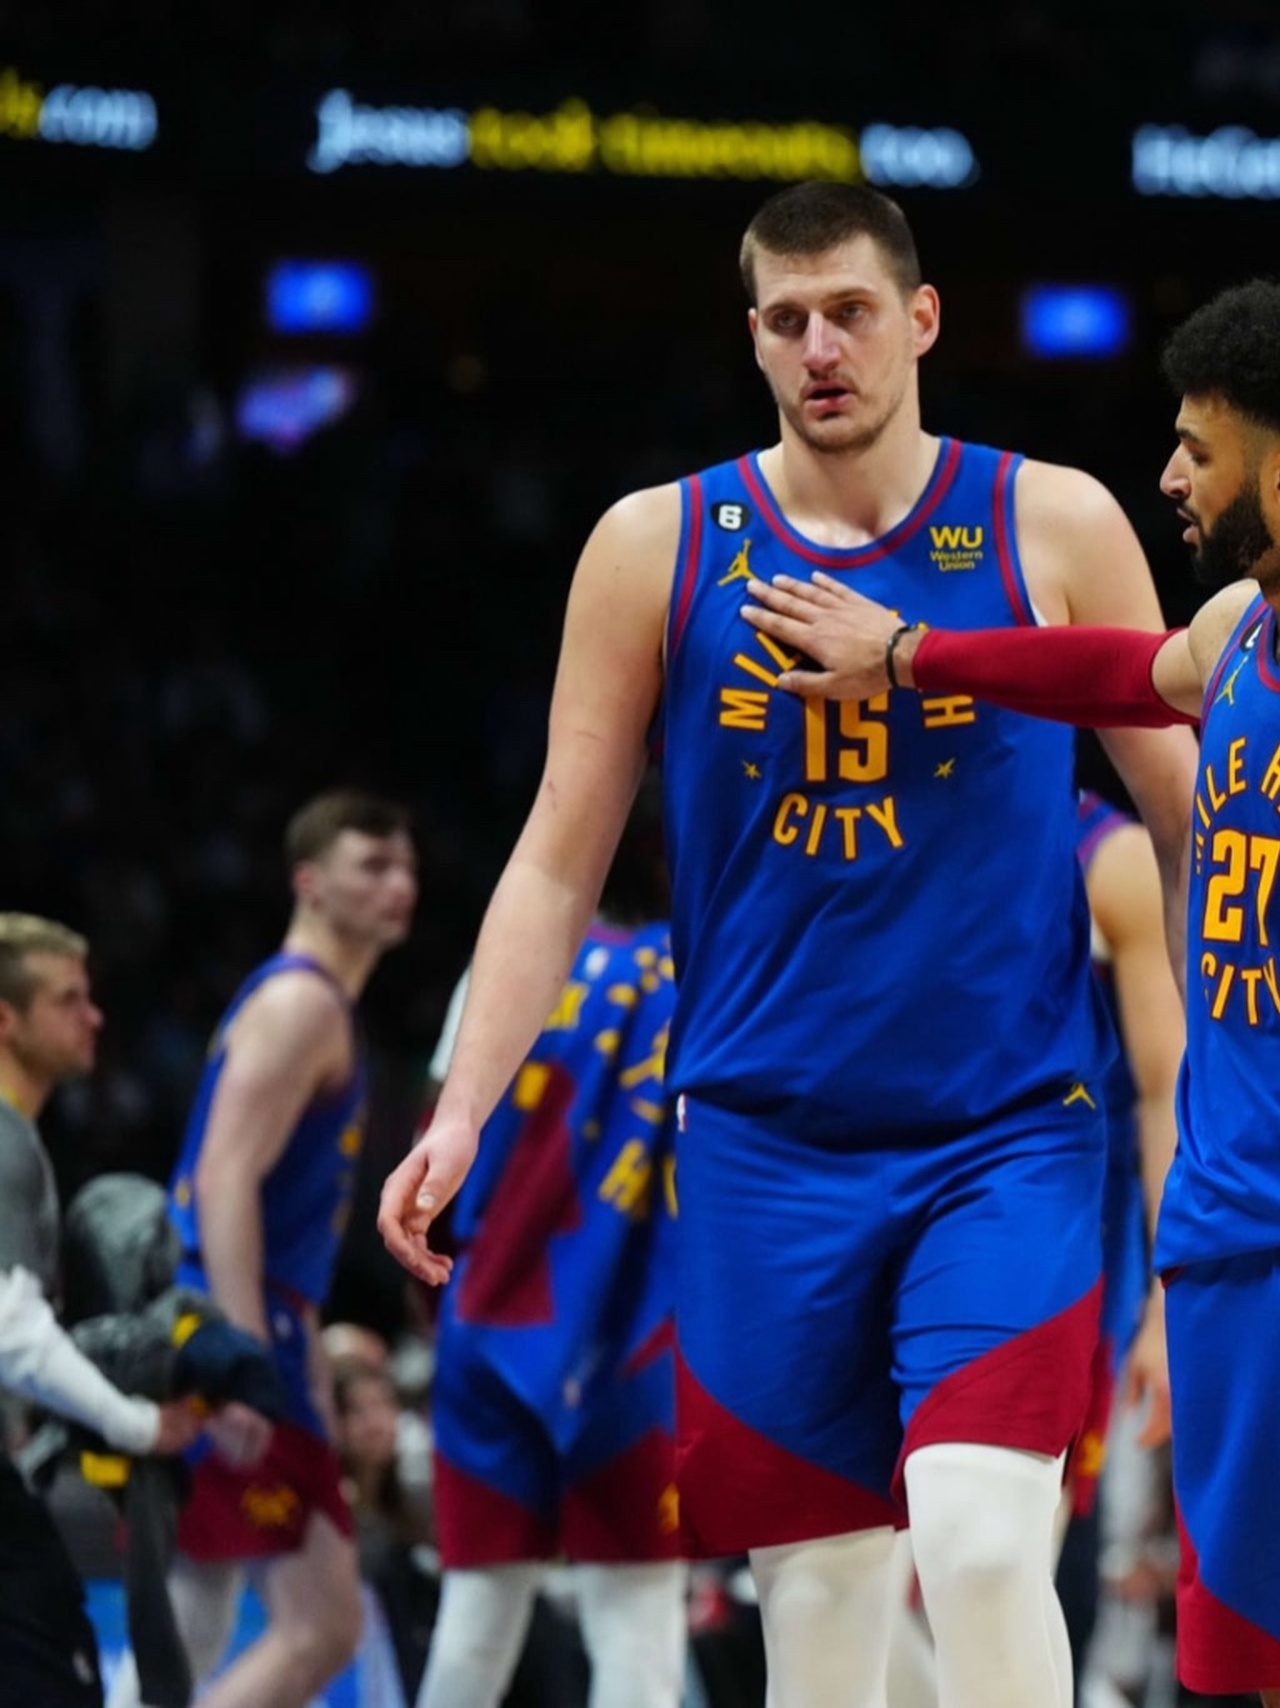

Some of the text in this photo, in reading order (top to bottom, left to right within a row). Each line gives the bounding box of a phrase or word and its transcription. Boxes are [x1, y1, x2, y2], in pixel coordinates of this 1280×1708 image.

[718, 505, 743, 530] 6
[930, 525, 983, 548] WU
[930, 549, 984, 562] Western
[938, 559, 976, 572] Union
[803, 693, 891, 783] 15
[772, 792, 906, 861] CITY
